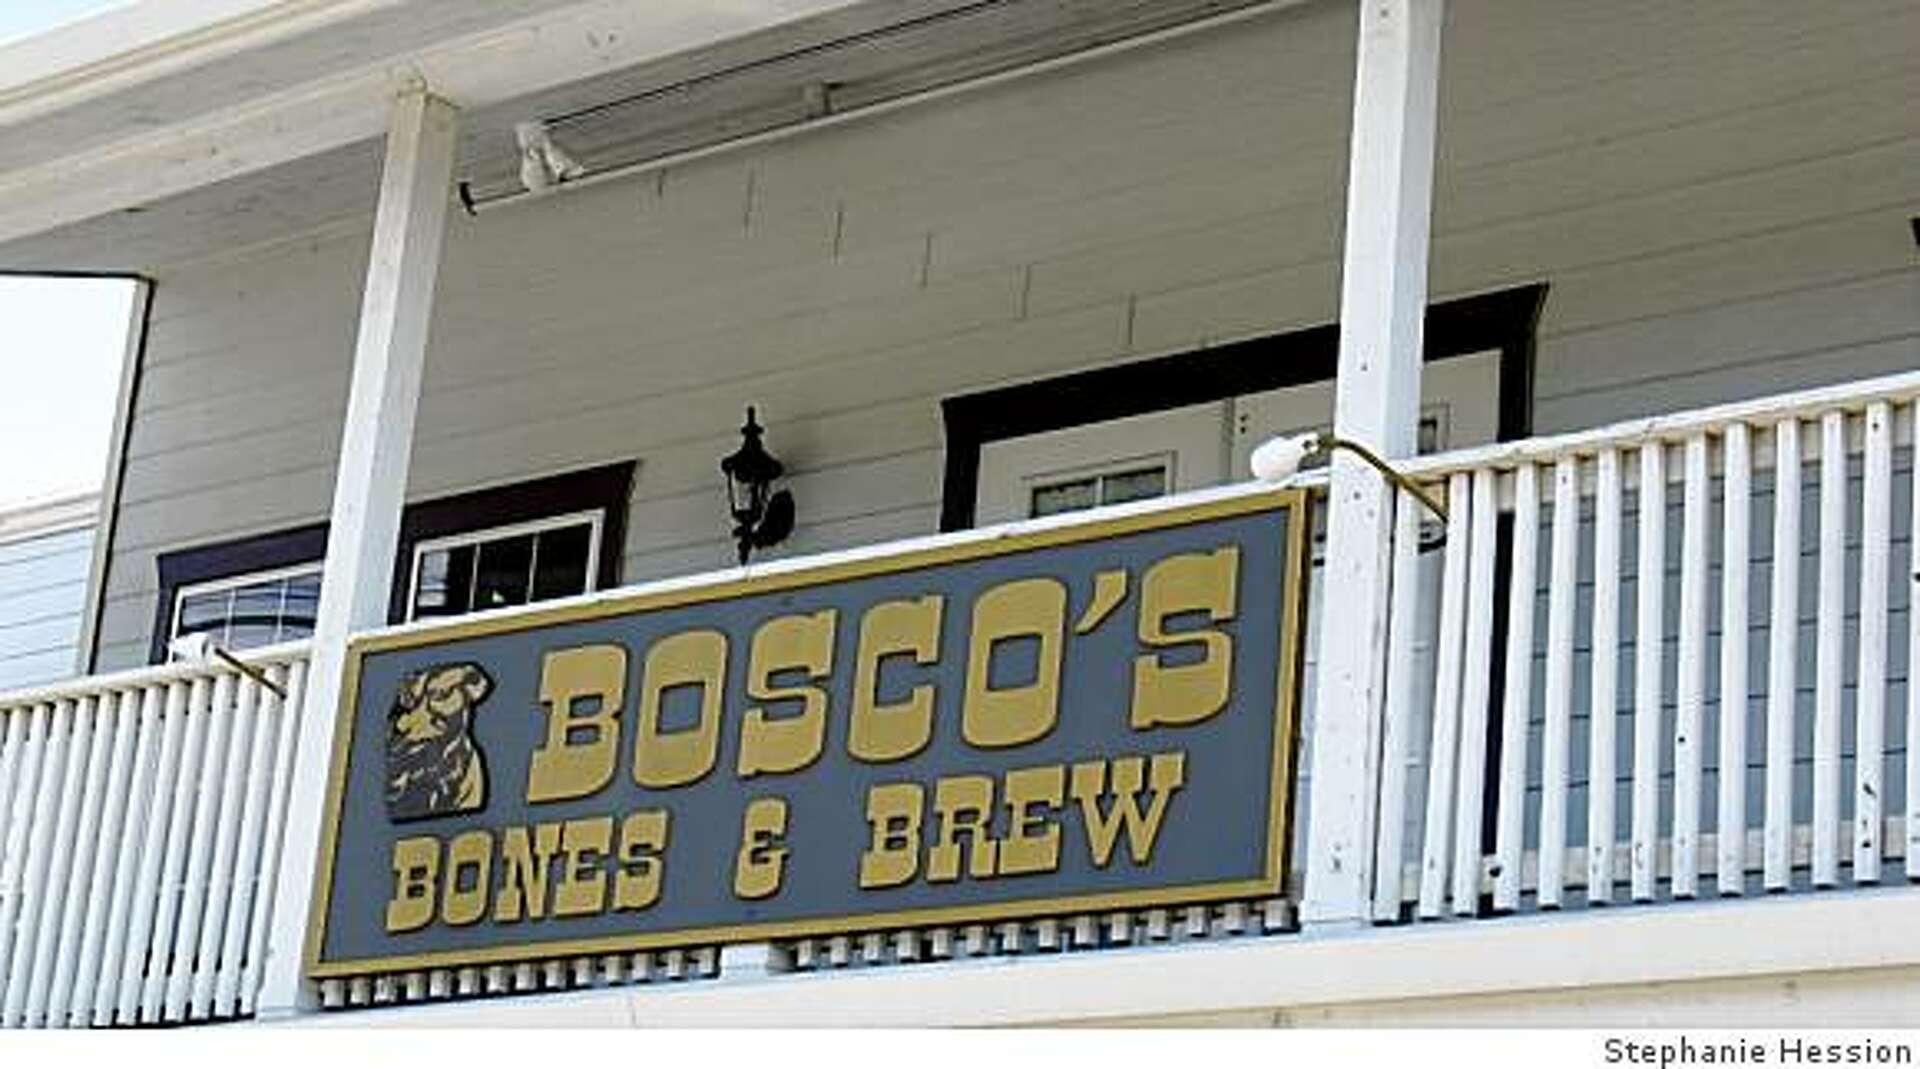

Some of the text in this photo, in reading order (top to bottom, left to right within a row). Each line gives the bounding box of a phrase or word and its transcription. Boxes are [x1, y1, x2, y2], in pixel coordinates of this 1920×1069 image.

[527, 547, 1240, 804] BOSCO'S
[385, 752, 1186, 934] BONES & BREW
